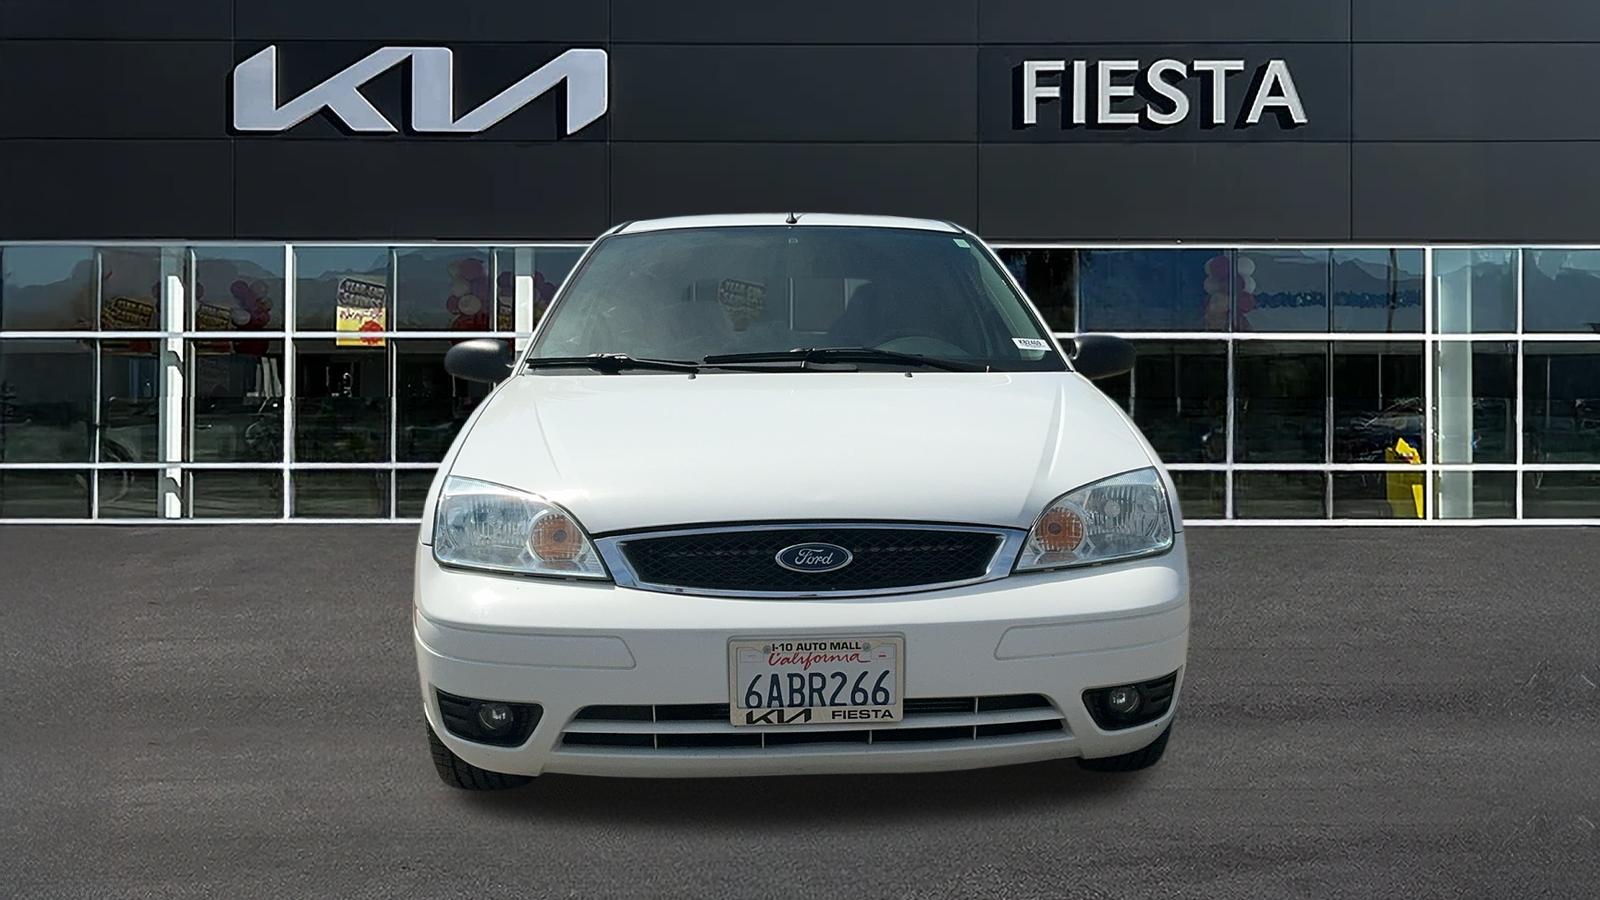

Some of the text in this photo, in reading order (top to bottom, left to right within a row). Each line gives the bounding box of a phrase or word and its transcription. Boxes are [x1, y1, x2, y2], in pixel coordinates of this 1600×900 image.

[233, 45, 608, 135] KIA
[1023, 59, 1308, 125] FIESTA
[794, 548, 834, 564] Ford
[771, 641, 862, 652] I-10 AUTO MALL
[768, 651, 871, 671] California
[745, 669, 890, 709] 6ABR266
[745, 708, 894, 725] KIA FIESTA
